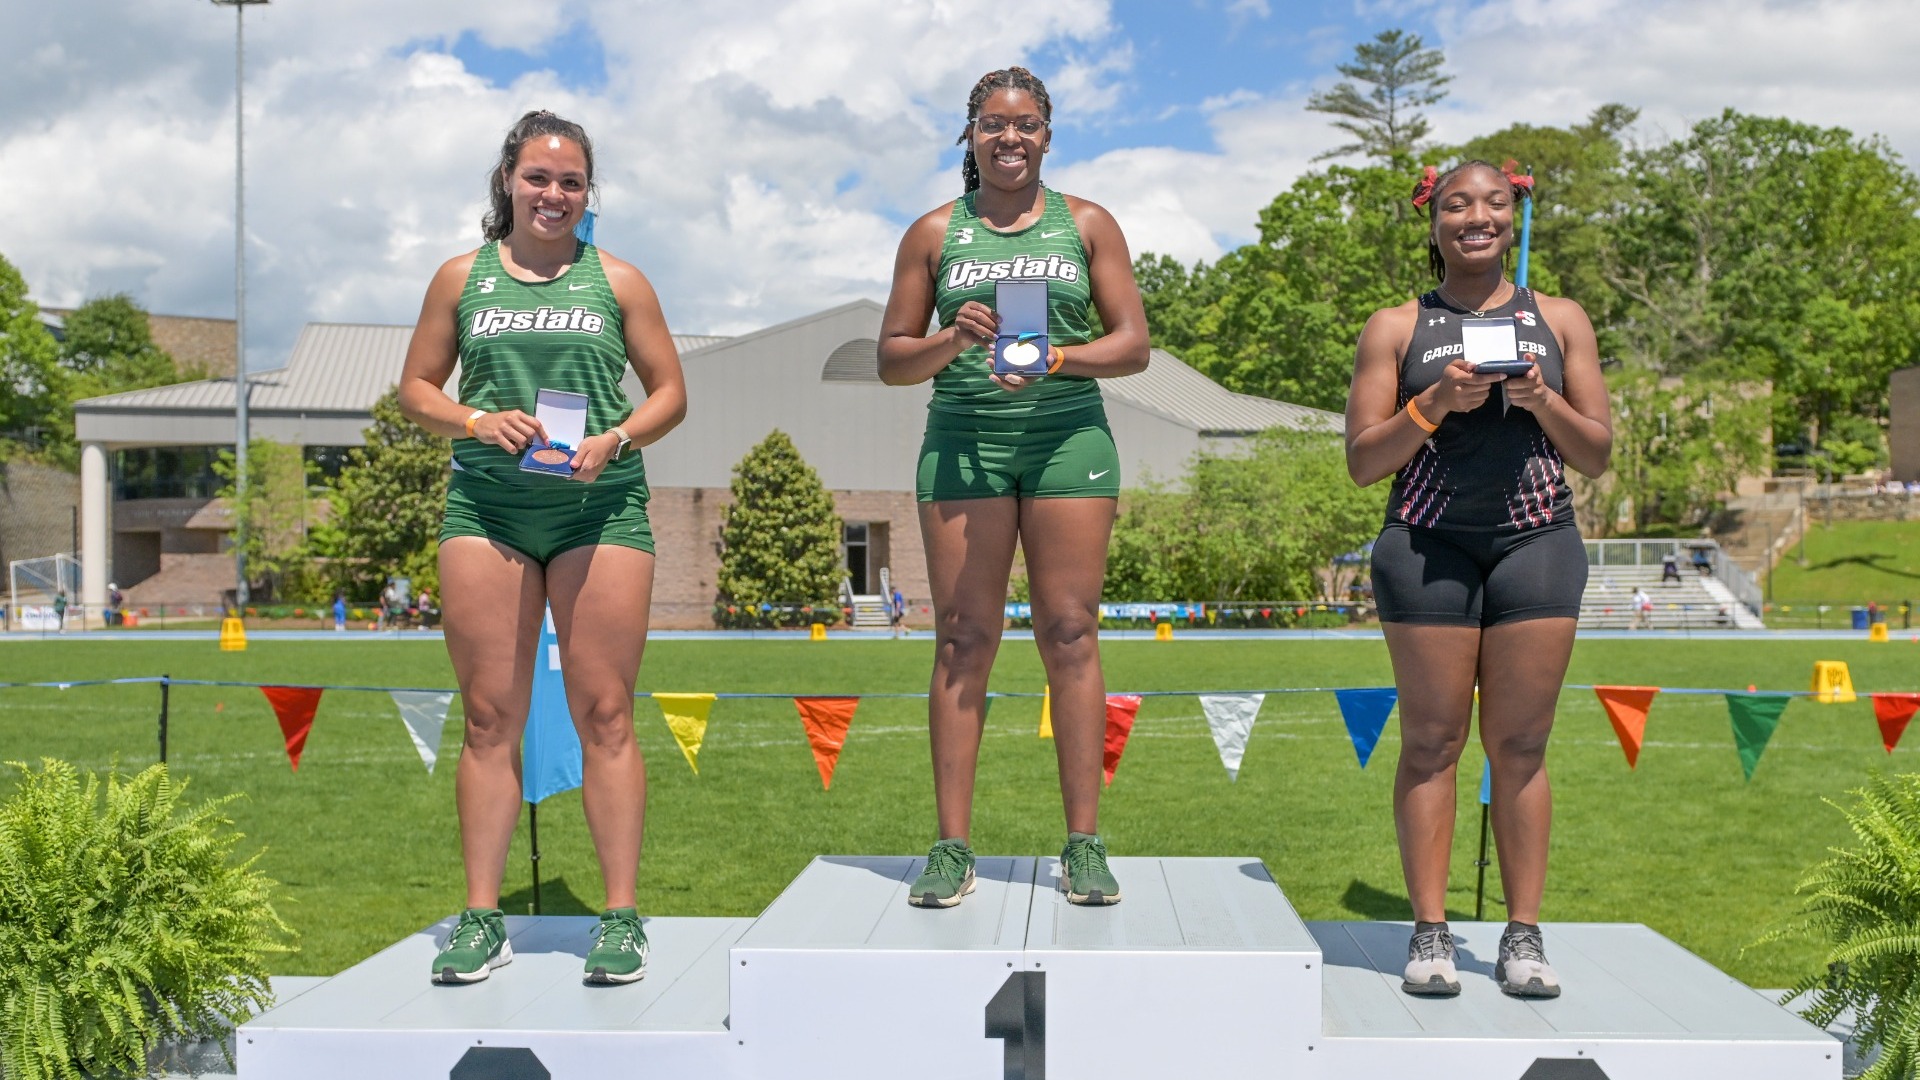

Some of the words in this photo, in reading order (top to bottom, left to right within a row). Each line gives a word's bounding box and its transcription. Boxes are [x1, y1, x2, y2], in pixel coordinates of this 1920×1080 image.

[946, 255, 1079, 290] Upstate
[470, 306, 604, 338] Upstate
[1422, 343, 1462, 363] GARD
[1518, 341, 1547, 356] EBB
[985, 971, 1046, 1080] 1
